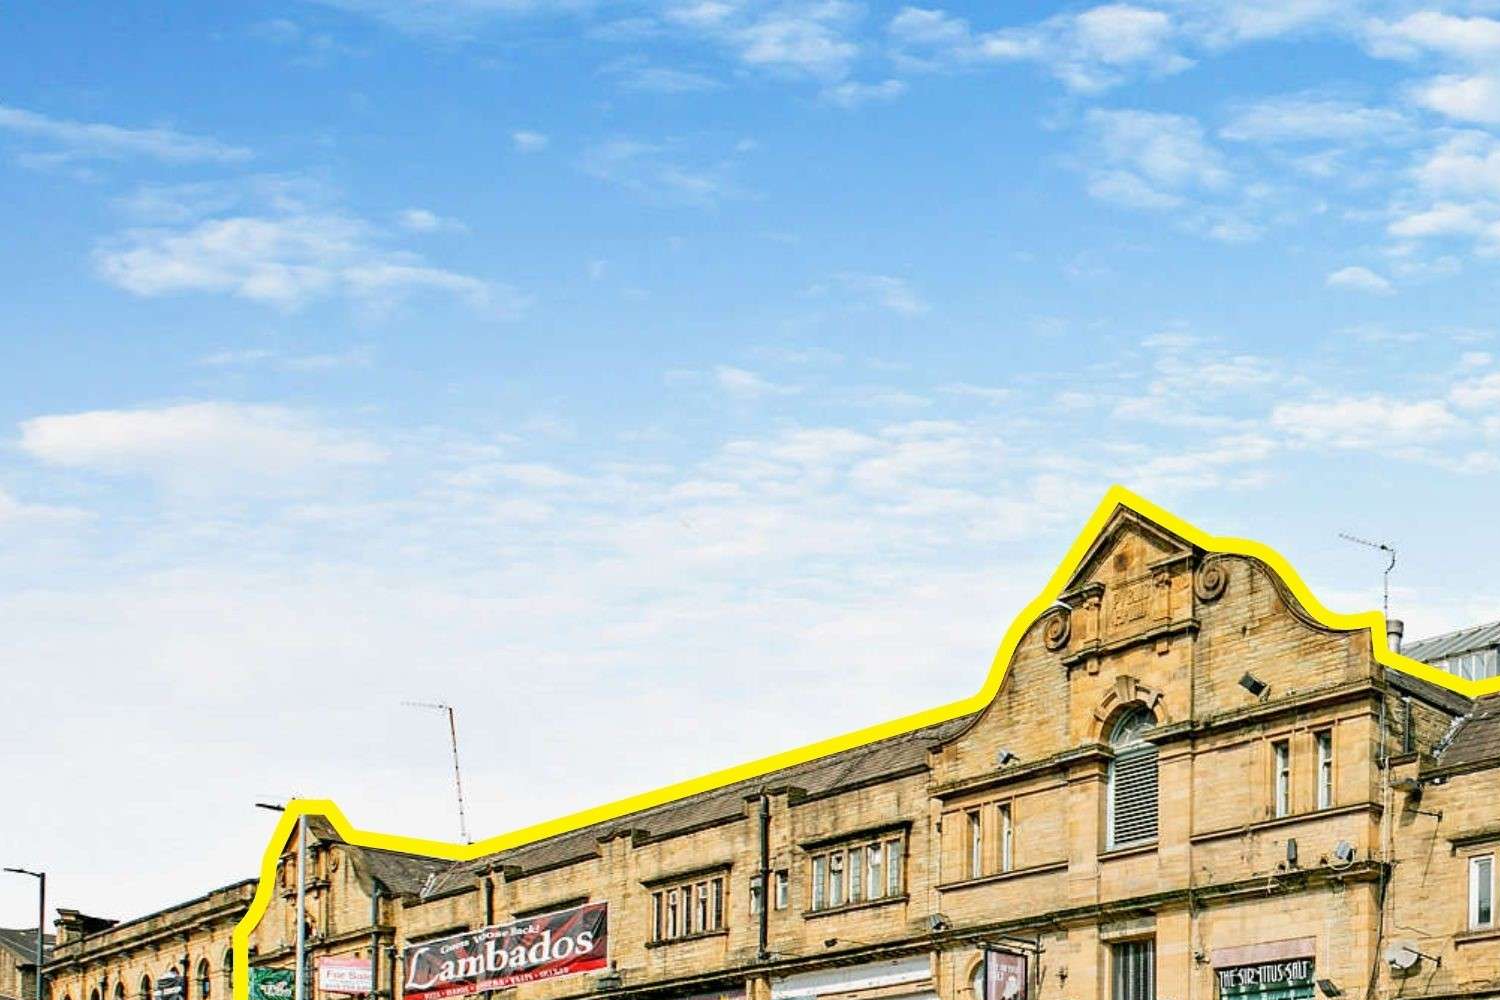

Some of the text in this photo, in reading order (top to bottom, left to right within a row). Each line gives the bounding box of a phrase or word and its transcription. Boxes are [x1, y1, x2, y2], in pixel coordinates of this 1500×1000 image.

[405, 930, 595, 990] Lambados
[1219, 961, 1309, 988] THE SIR TITUS SALT
